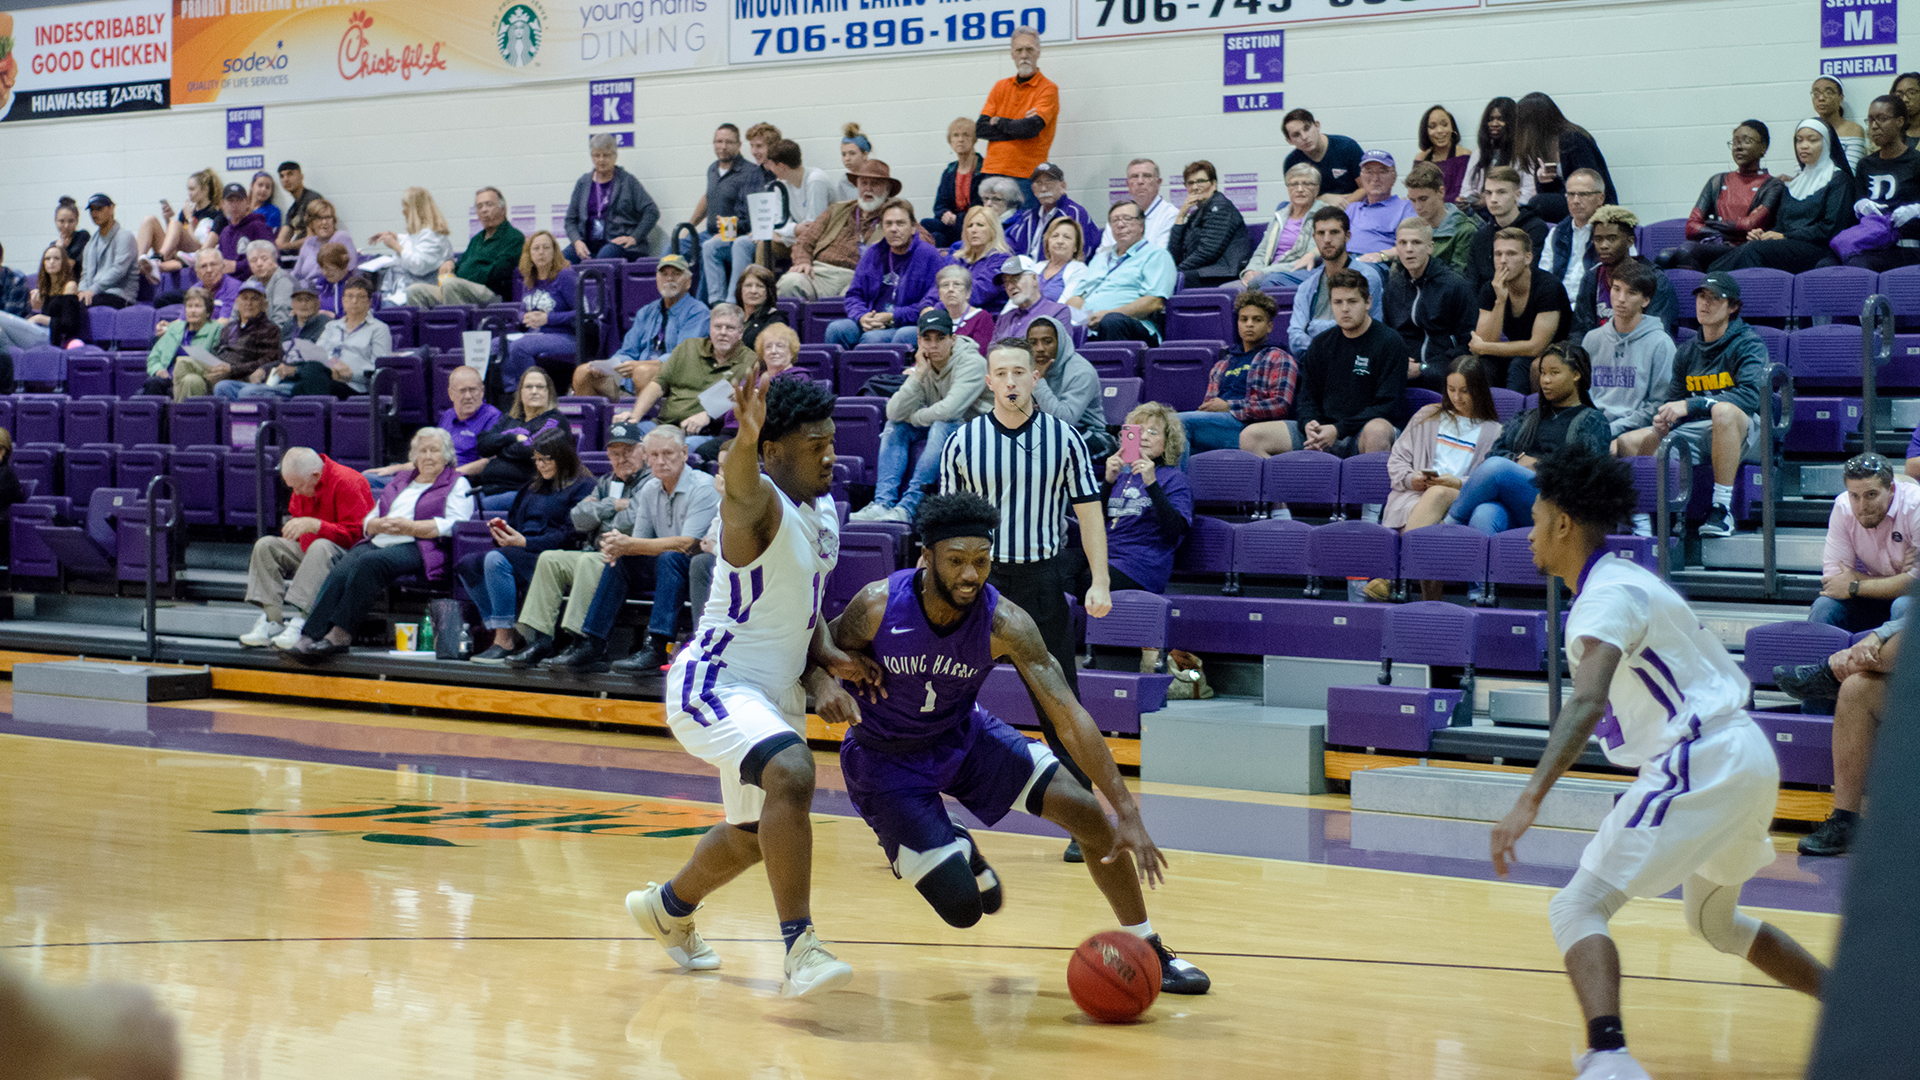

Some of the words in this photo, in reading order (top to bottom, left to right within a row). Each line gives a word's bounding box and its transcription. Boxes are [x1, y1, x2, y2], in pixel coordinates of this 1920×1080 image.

[579, 1, 644, 29] young
[1843, 10, 1873, 41] M
[35, 13, 165, 46] INDESCRIBABLY
[581, 22, 706, 60] DINING
[751, 7, 1046, 56] 706-896-1860
[338, 23, 447, 80] Chick-fil-A
[1227, 34, 1281, 51] SECTION
[32, 50, 84, 75] GOOD
[90, 42, 168, 69] CHICKEN
[222, 51, 288, 73] sodexo
[1245, 52, 1262, 80] L
[1823, 57, 1894, 76] GENERAL
[187, 79, 219, 93] QUALITY
[221, 78, 231, 89] OF
[233, 76, 249, 88] LIFE
[251, 74, 289, 87] SERVICES
[591, 82, 632, 96] SECTION
[31, 89, 108, 113] HIAWASSEE
[110, 83, 164, 108] ZAXBY'S
[603, 97, 620, 122] K
[1237, 95, 1269, 110] V.I.P.
[229, 109, 262, 122] SECTION
[239, 123, 252, 146] J
[1685, 371, 1735, 391] STMA
[883, 654, 927, 675] YOUNG
[920, 681, 937, 713] 1
